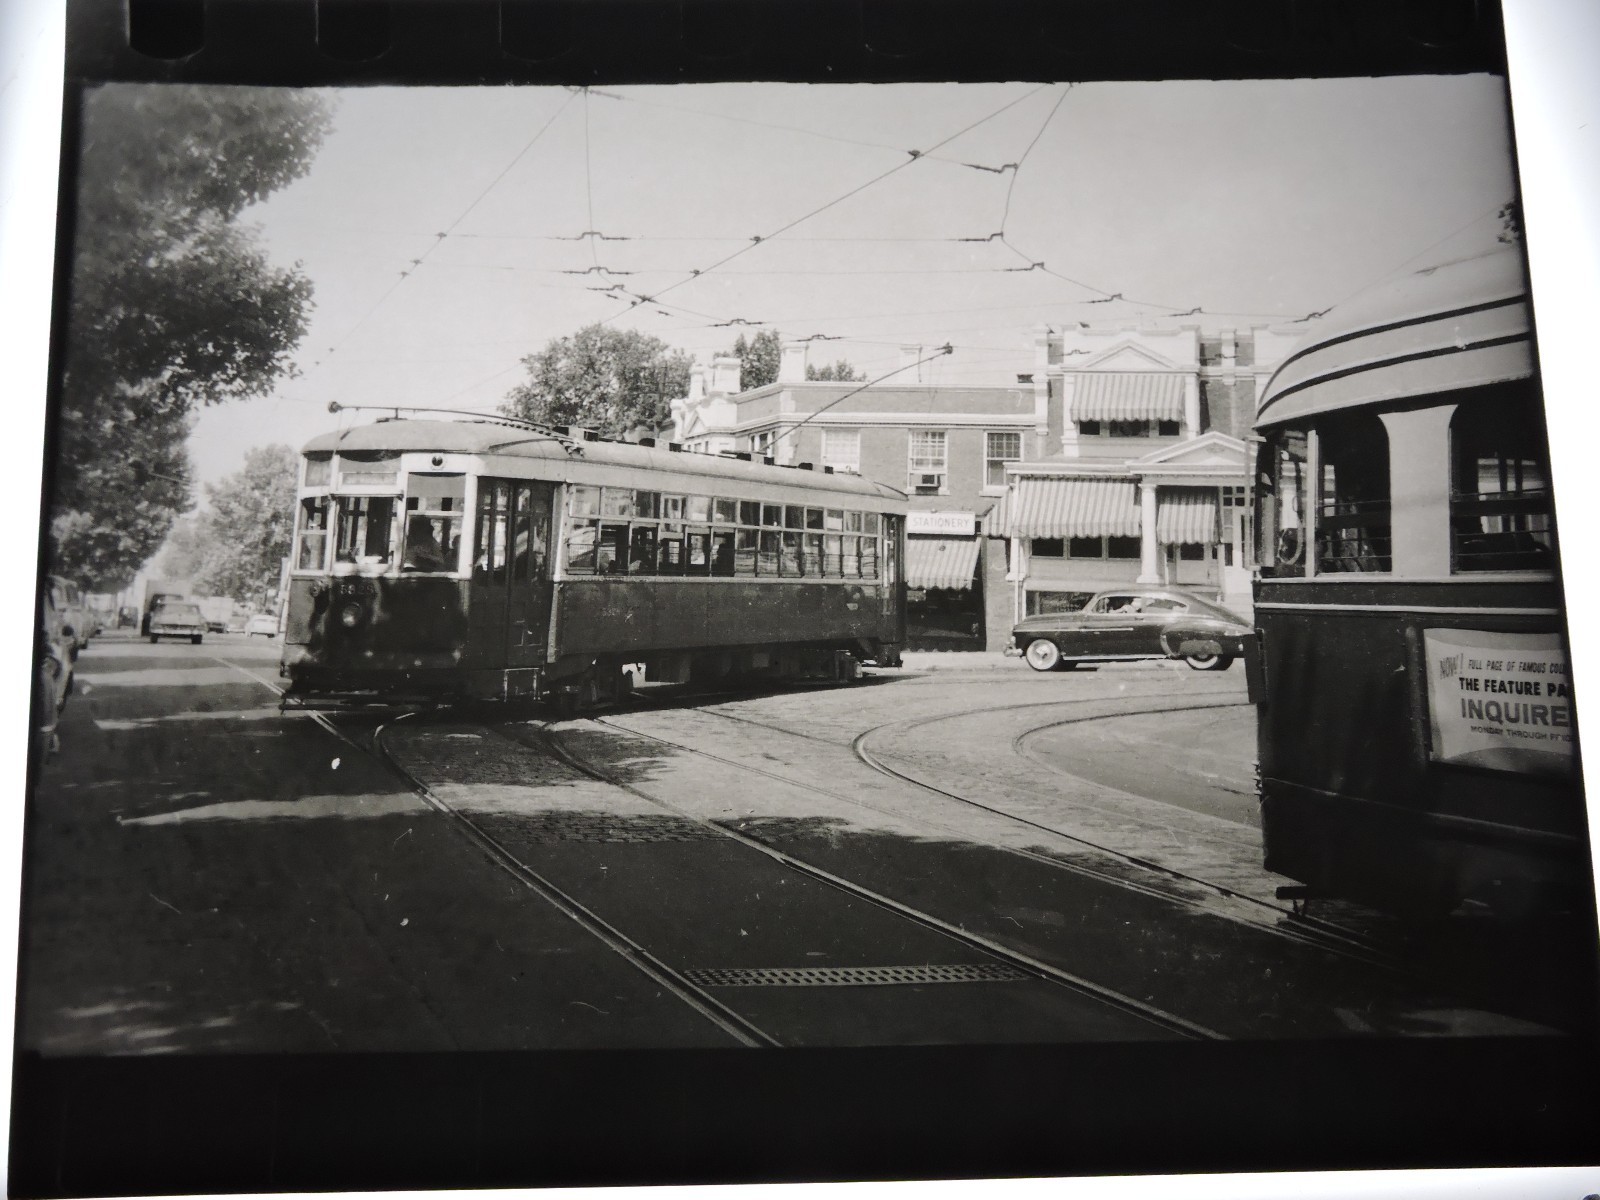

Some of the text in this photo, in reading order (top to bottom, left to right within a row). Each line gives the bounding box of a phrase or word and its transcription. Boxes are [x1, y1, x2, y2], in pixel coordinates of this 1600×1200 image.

[912, 517, 970, 528] STATIONERY
[1468, 659, 1482, 670] FULL
[1486, 660, 1503, 672] PAGE
[1507, 661, 1516, 672] OF
[1519, 662, 1546, 674] FAMOUS
[1459, 676, 1479, 692] THE
[1484, 679, 1541, 696] FEATURE
[1461, 698, 1569, 728] INQUIRE
[1471, 725, 1503, 736] MONDAY
[1507, 729, 1547, 740] THROUGH
